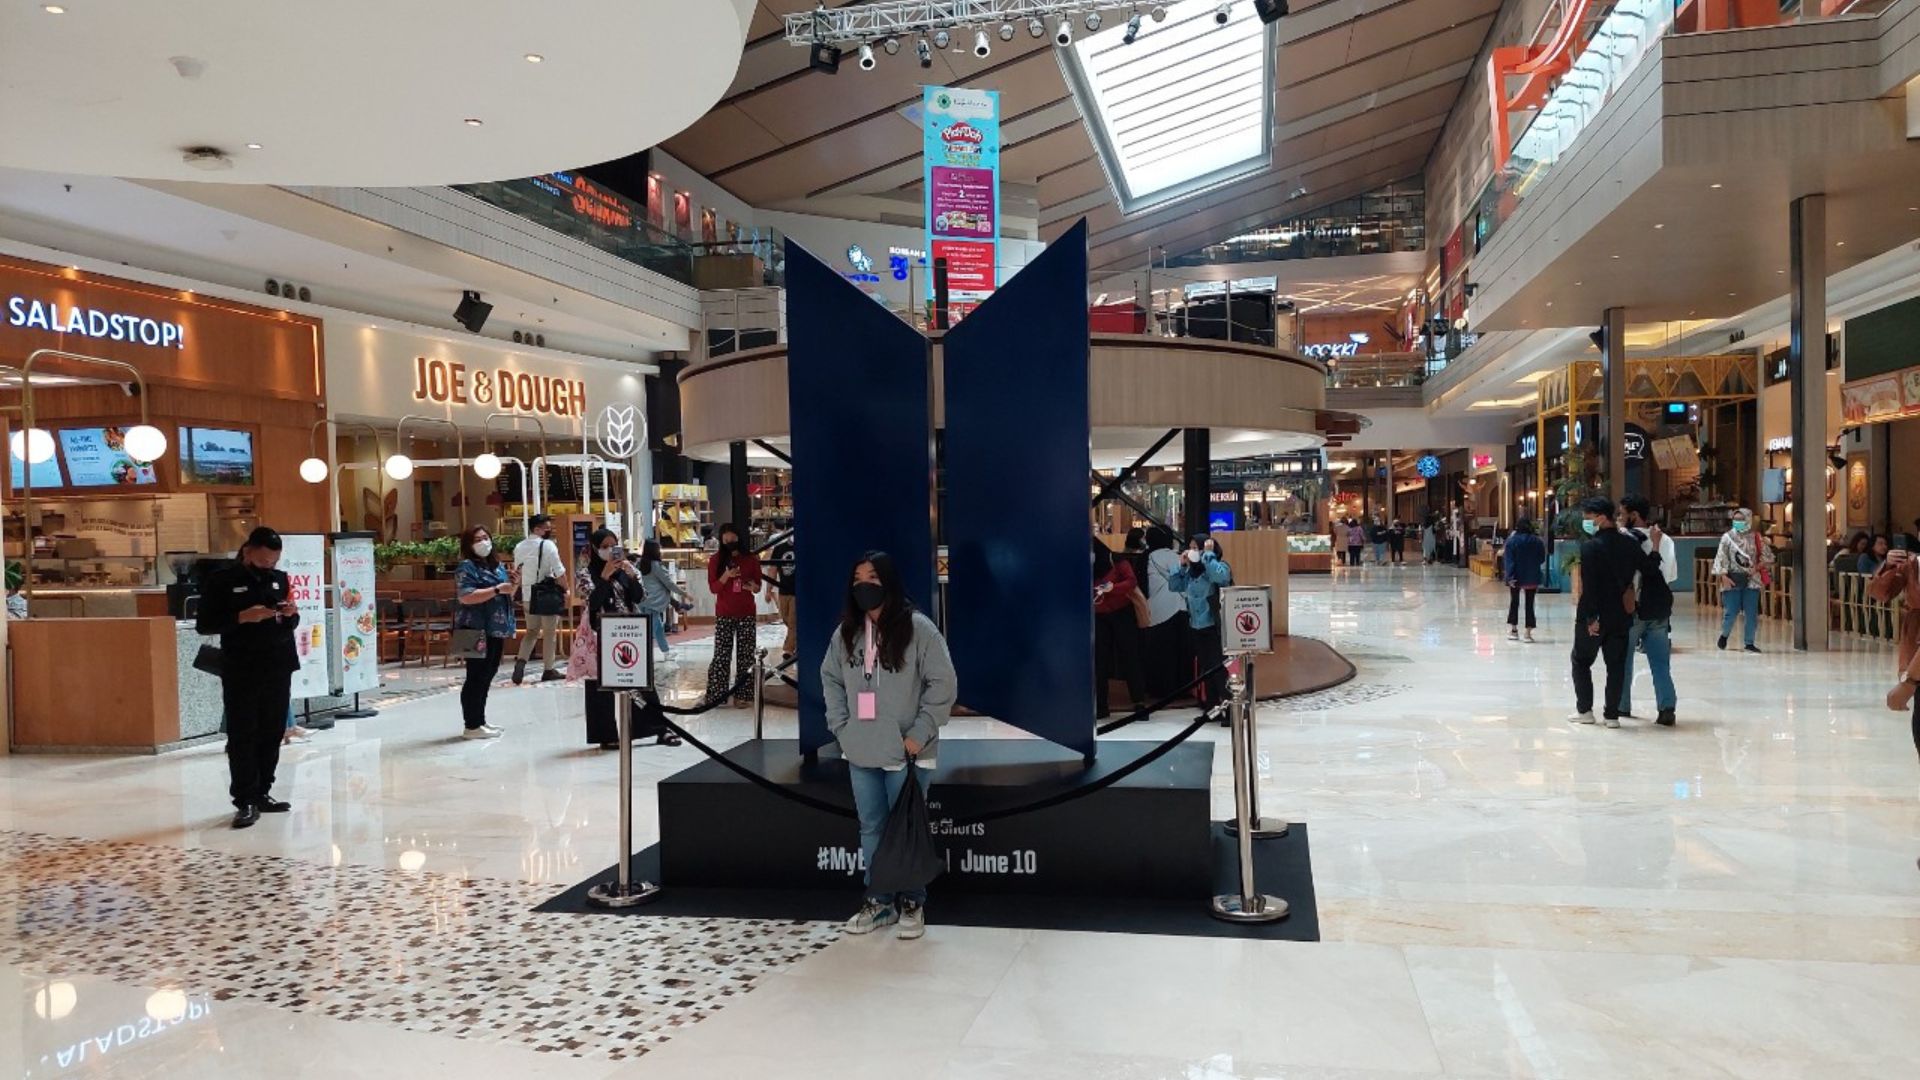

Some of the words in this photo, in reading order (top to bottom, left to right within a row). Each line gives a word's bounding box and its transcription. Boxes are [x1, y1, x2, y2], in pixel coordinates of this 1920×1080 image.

[9, 297, 185, 349] SALADSTOP!
[415, 357, 468, 404] JOE
[473, 370, 493, 404] &
[497, 369, 587, 417] DOUGH
[293, 589, 310, 600] OR
[314, 589, 320, 600] 2
[960, 849, 1009, 873] June
[1012, 849, 1037, 874] 10
